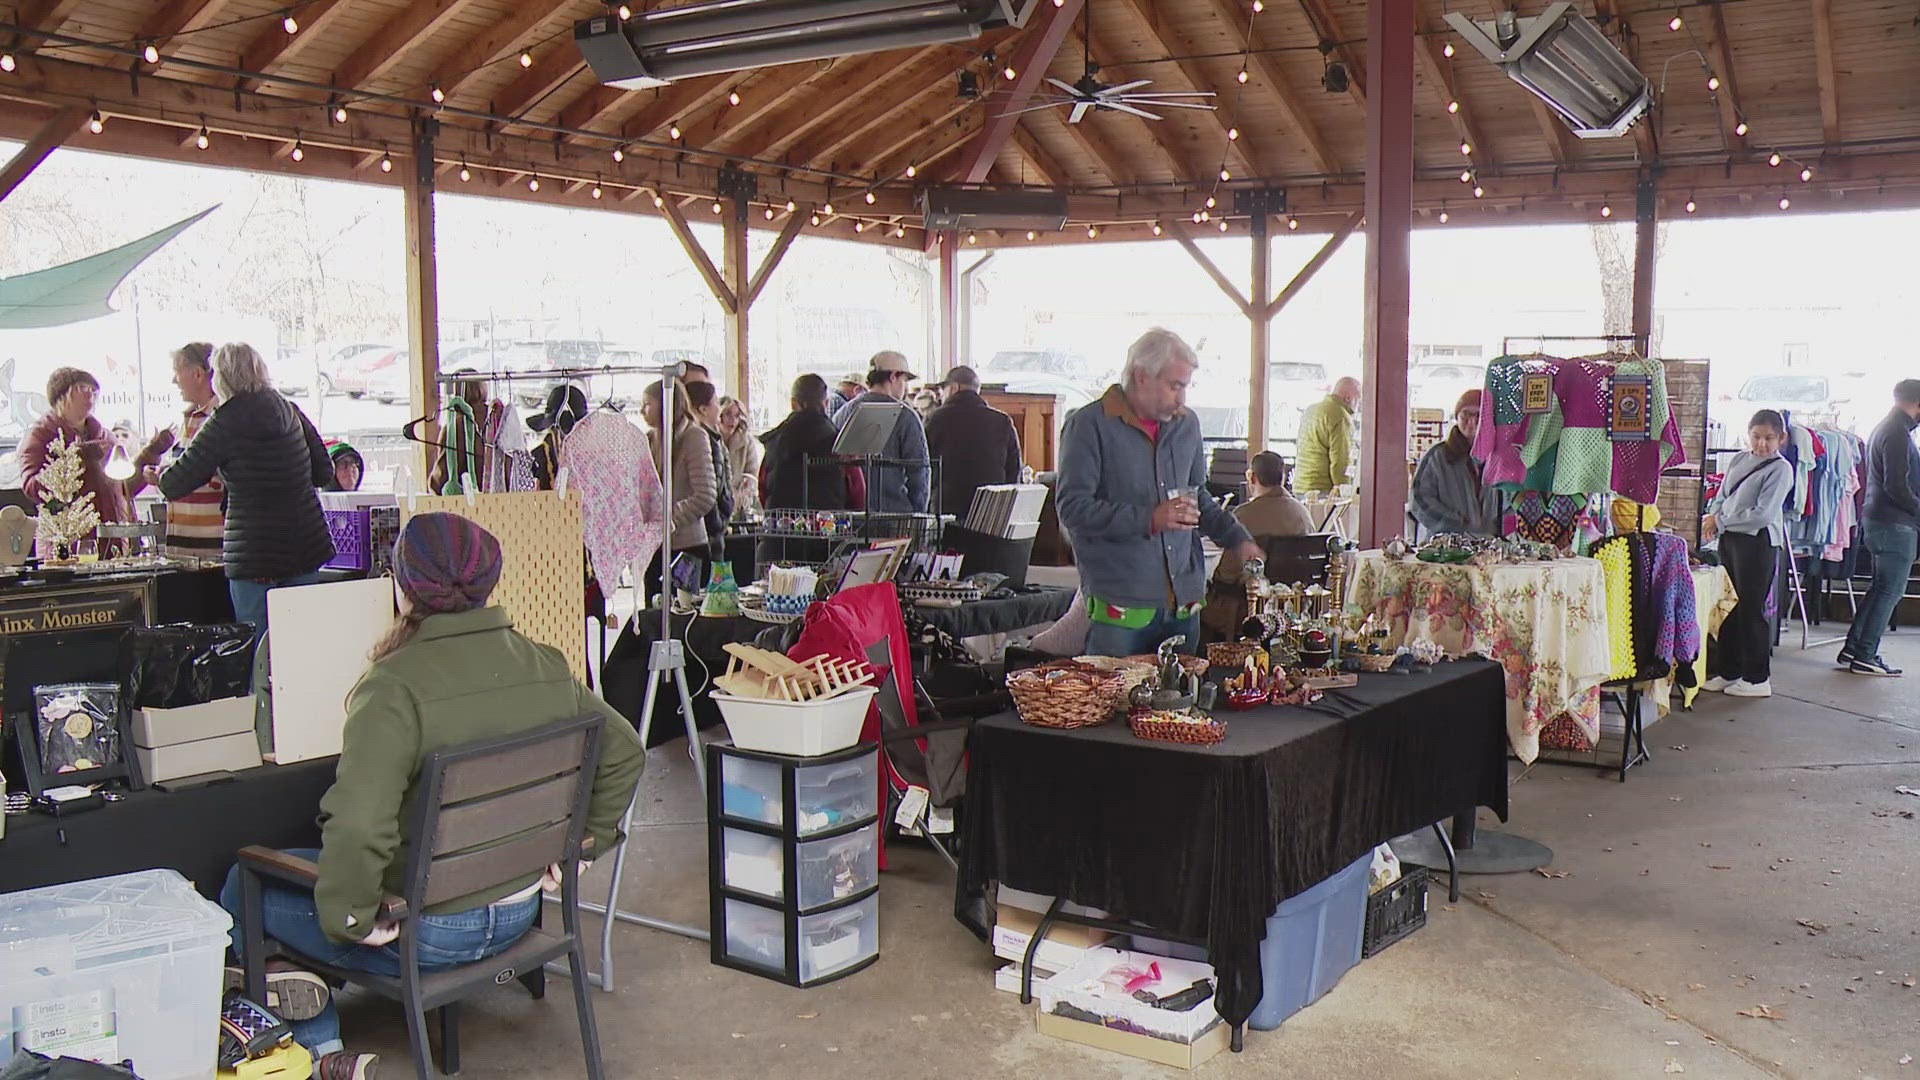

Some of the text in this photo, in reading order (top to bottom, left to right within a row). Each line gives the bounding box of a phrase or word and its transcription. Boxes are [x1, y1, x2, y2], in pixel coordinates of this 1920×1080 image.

[101, 391, 136, 404] uble
[0, 608, 117, 634] inx Monster
